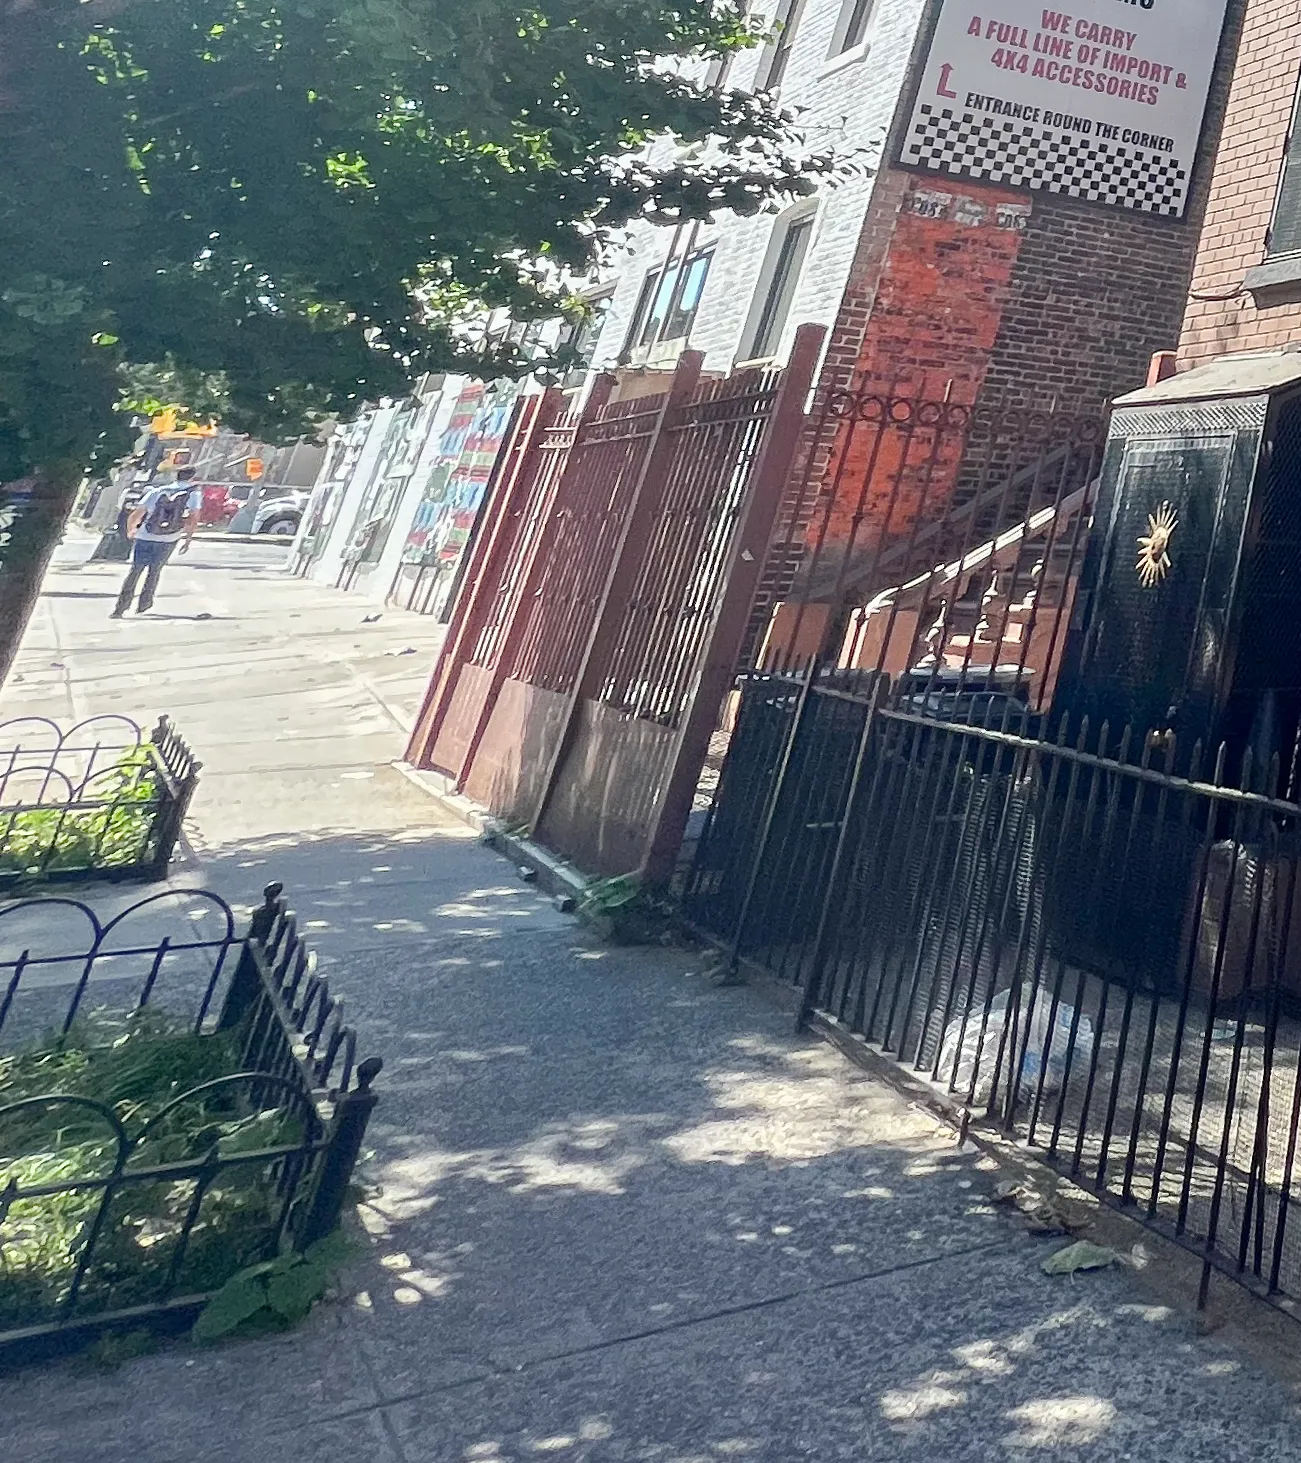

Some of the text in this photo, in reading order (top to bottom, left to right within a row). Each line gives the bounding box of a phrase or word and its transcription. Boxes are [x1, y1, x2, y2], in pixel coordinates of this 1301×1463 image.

[967, 16, 1188, 89] A FULL LINE OF IMPORT &
[1041, 9, 1138, 51] WE CARRY
[991, 47, 1160, 105] 4X4 ACCESSORIES
[964, 92, 1175, 152] ENTRANCE ROUND THE CORNER
